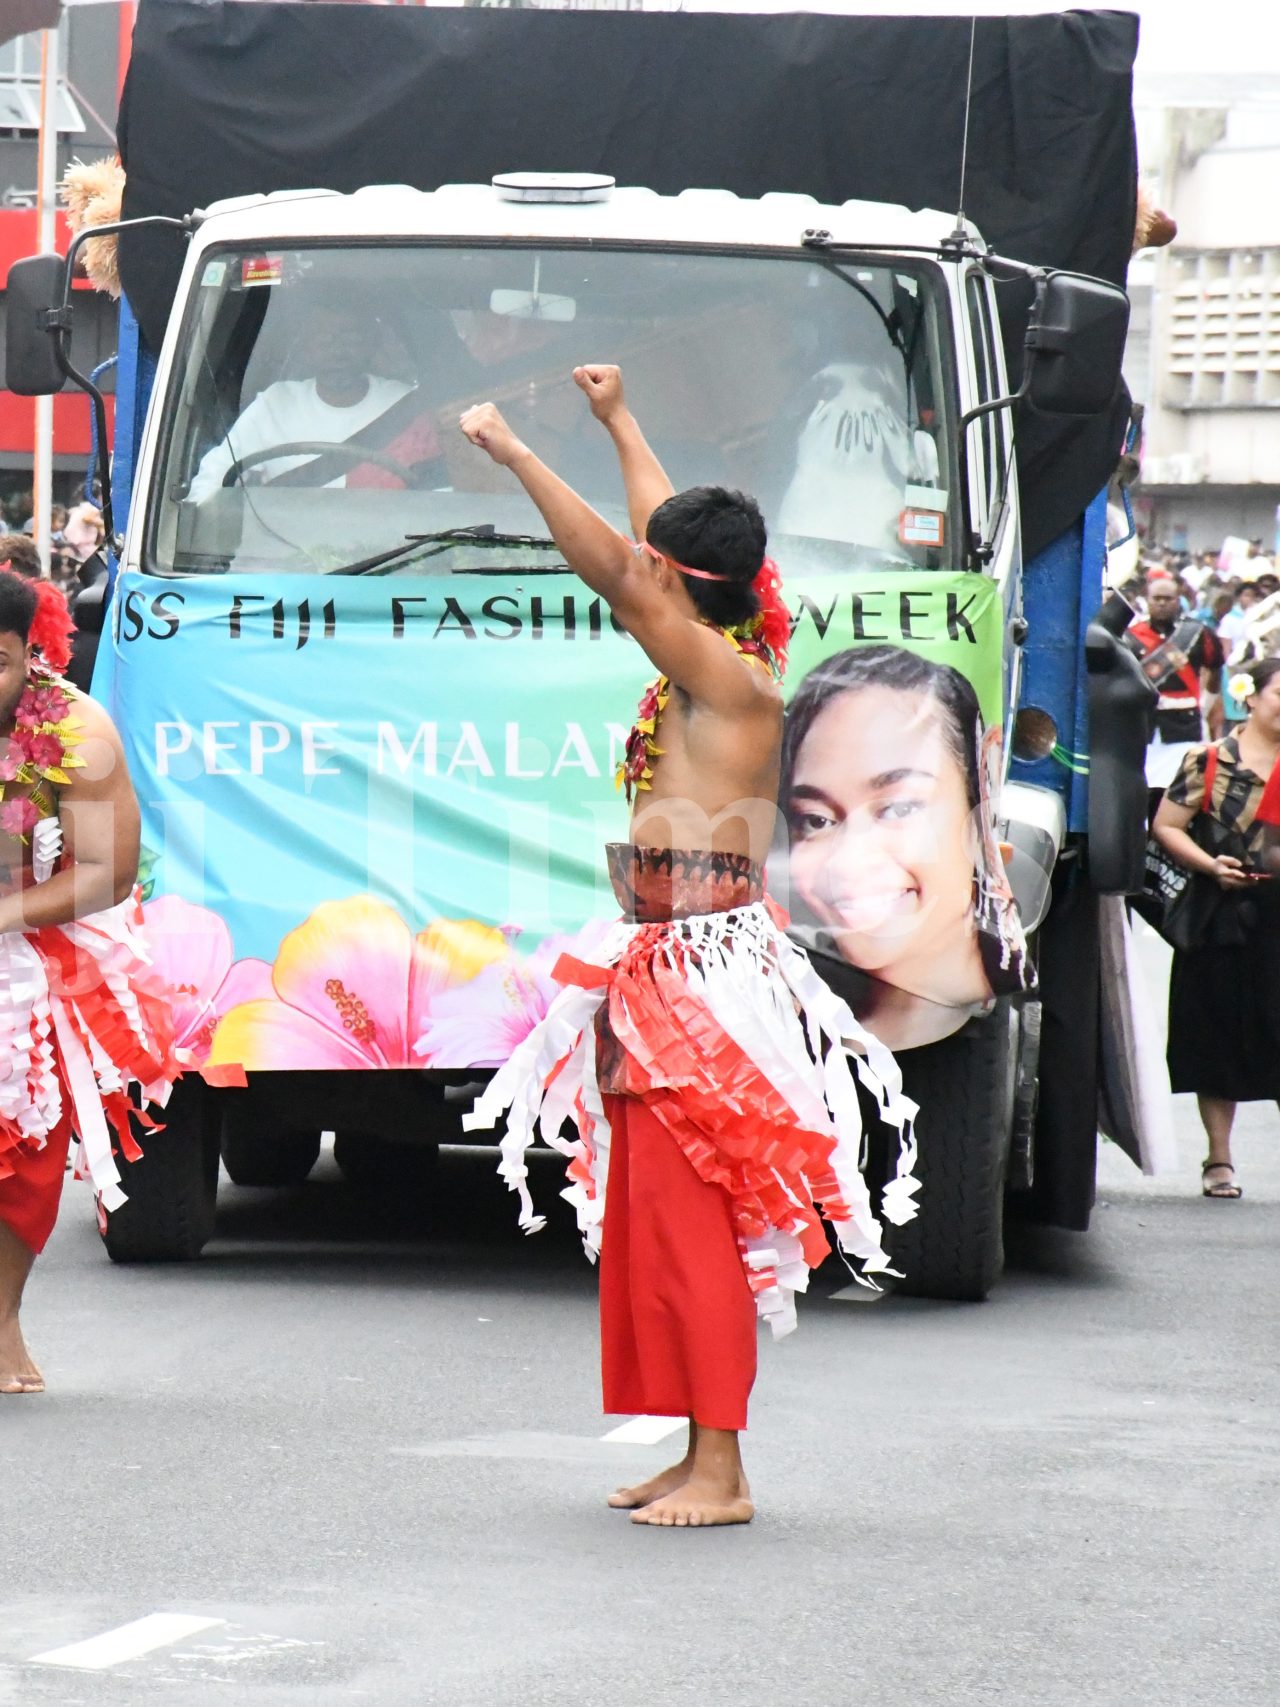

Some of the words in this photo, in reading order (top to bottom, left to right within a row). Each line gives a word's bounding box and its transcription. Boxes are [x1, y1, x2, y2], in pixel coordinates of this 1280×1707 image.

[117, 590, 186, 643] SS
[229, 593, 337, 651] FIJI
[154, 721, 342, 777] PEPE
